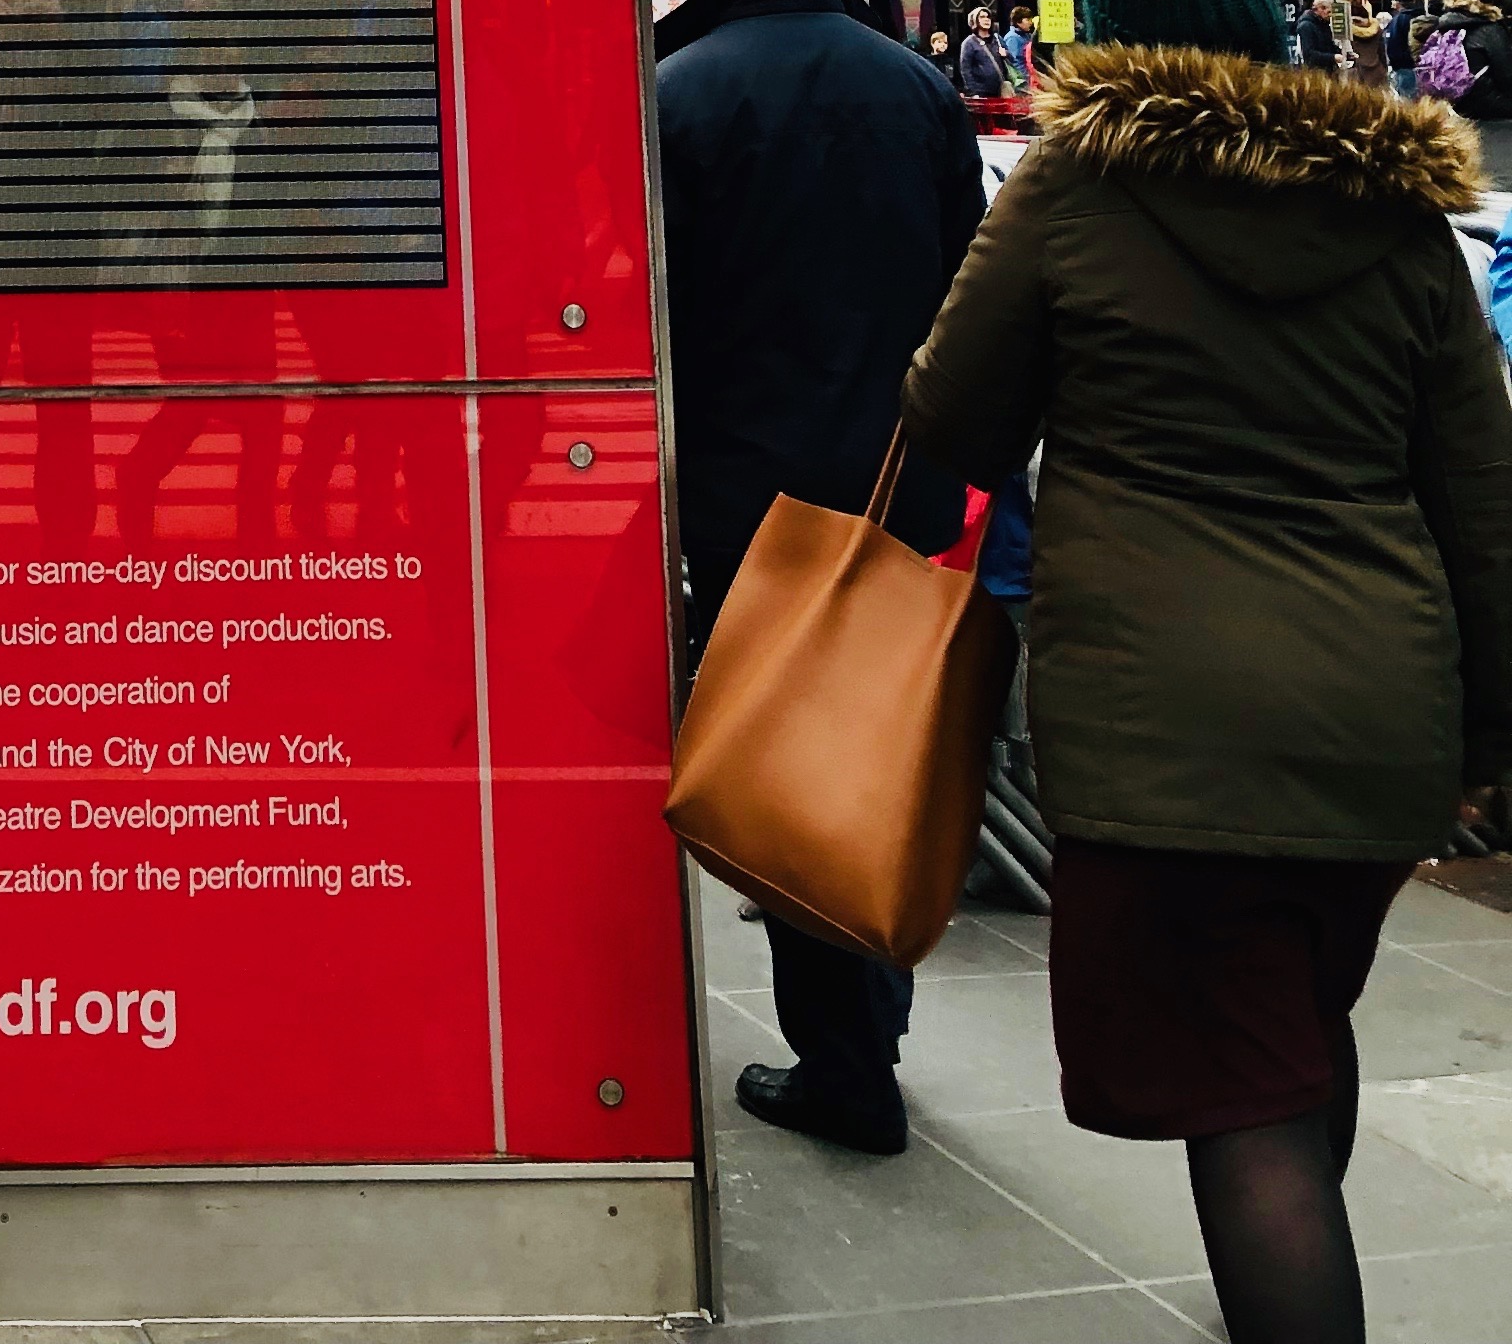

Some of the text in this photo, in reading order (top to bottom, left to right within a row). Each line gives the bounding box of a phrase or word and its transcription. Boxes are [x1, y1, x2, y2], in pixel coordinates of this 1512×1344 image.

[25, 554, 167, 590] same-day
[174, 553, 293, 584] discount
[298, 551, 389, 582] tickets
[394, 551, 423, 581] to
[63, 615, 119, 646] and
[124, 614, 214, 644] dance
[221, 611, 393, 649] productions.
[28, 676, 196, 713] cooperation
[202, 674, 232, 704] of
[47, 737, 93, 767] the
[102, 736, 159, 774] City
[166, 735, 197, 766] of
[204, 735, 271, 766] New
[278, 733, 353, 769] York,
[69, 797, 261, 835] Development
[267, 795, 349, 830] Fund,
[89, 861, 126, 892] for
[134, 860, 181, 891] the
[187, 857, 343, 898] performing
[350, 858, 413, 889] arts.
